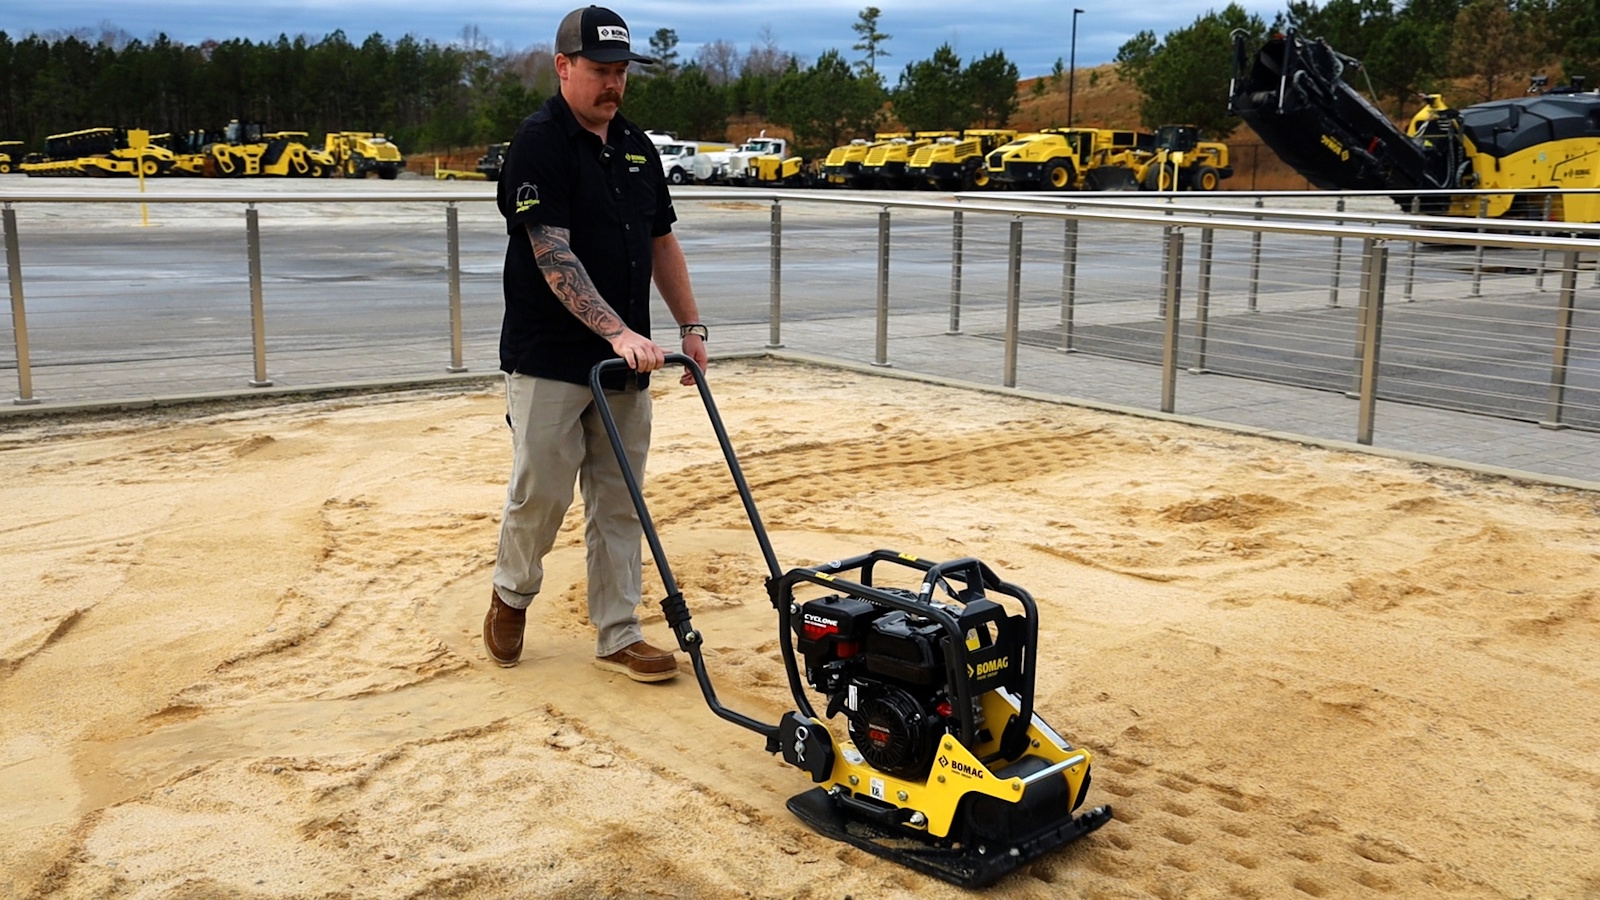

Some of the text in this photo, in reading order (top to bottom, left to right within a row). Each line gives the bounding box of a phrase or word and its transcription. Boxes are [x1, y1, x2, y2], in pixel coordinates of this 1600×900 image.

[804, 613, 838, 627] CYCLONE
[976, 656, 1009, 676] BOMAG
[869, 723, 890, 734] HONDA
[870, 730, 889, 743] GX
[952, 760, 983, 779] BOMAG
